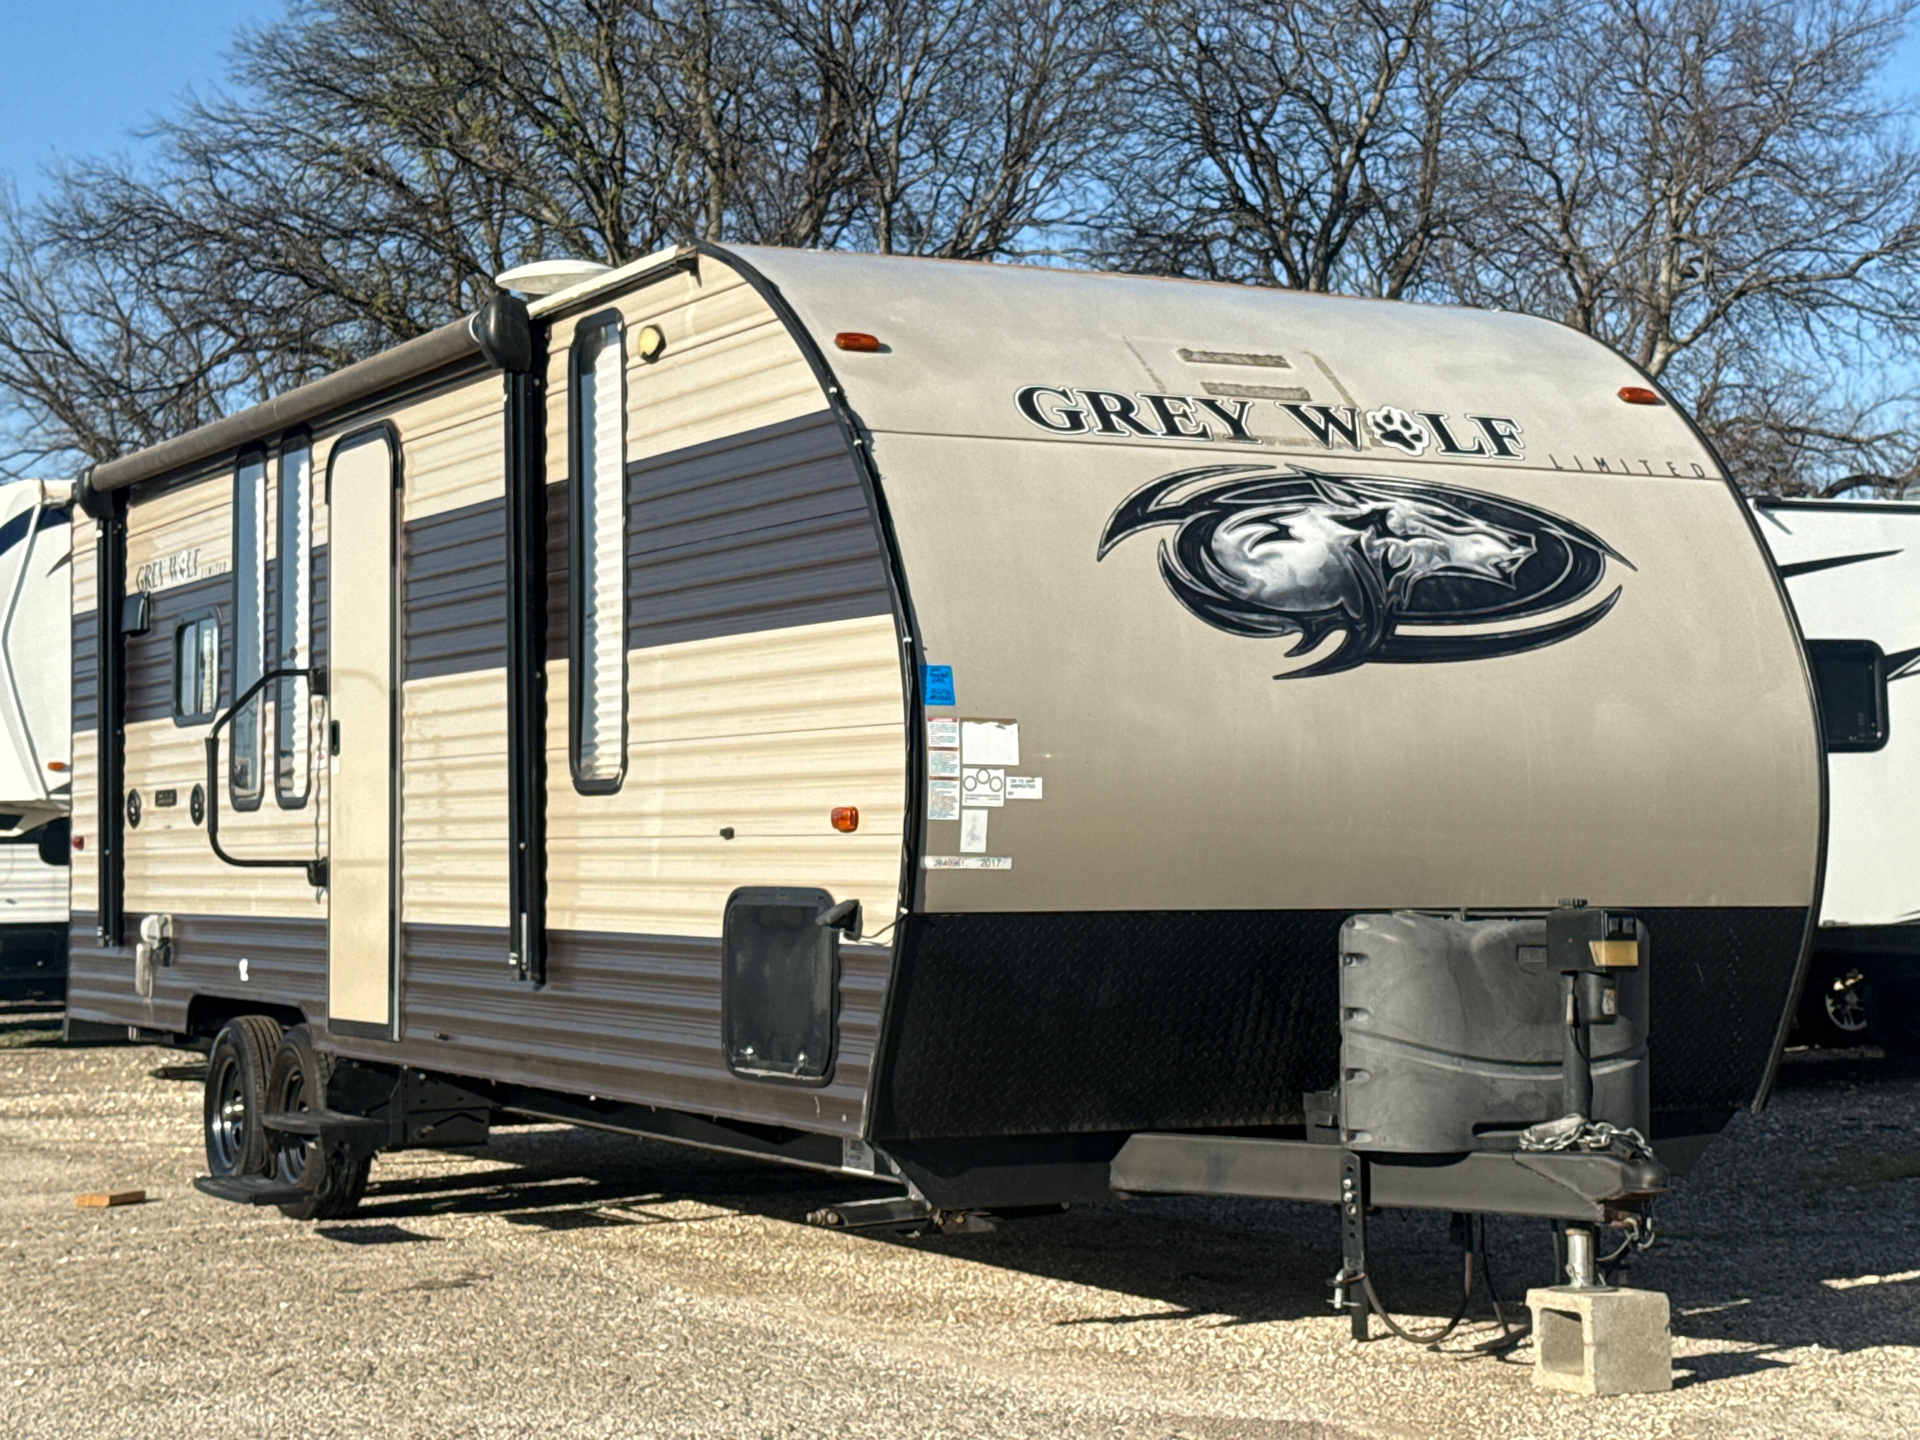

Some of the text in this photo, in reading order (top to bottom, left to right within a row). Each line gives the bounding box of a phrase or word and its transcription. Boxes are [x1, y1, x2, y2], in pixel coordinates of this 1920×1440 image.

[1015, 385, 1262, 444] GREY
[1549, 454, 1705, 479] LIMITED
[136, 559, 167, 591] GREY
[980, 858, 1001, 867] 2017
